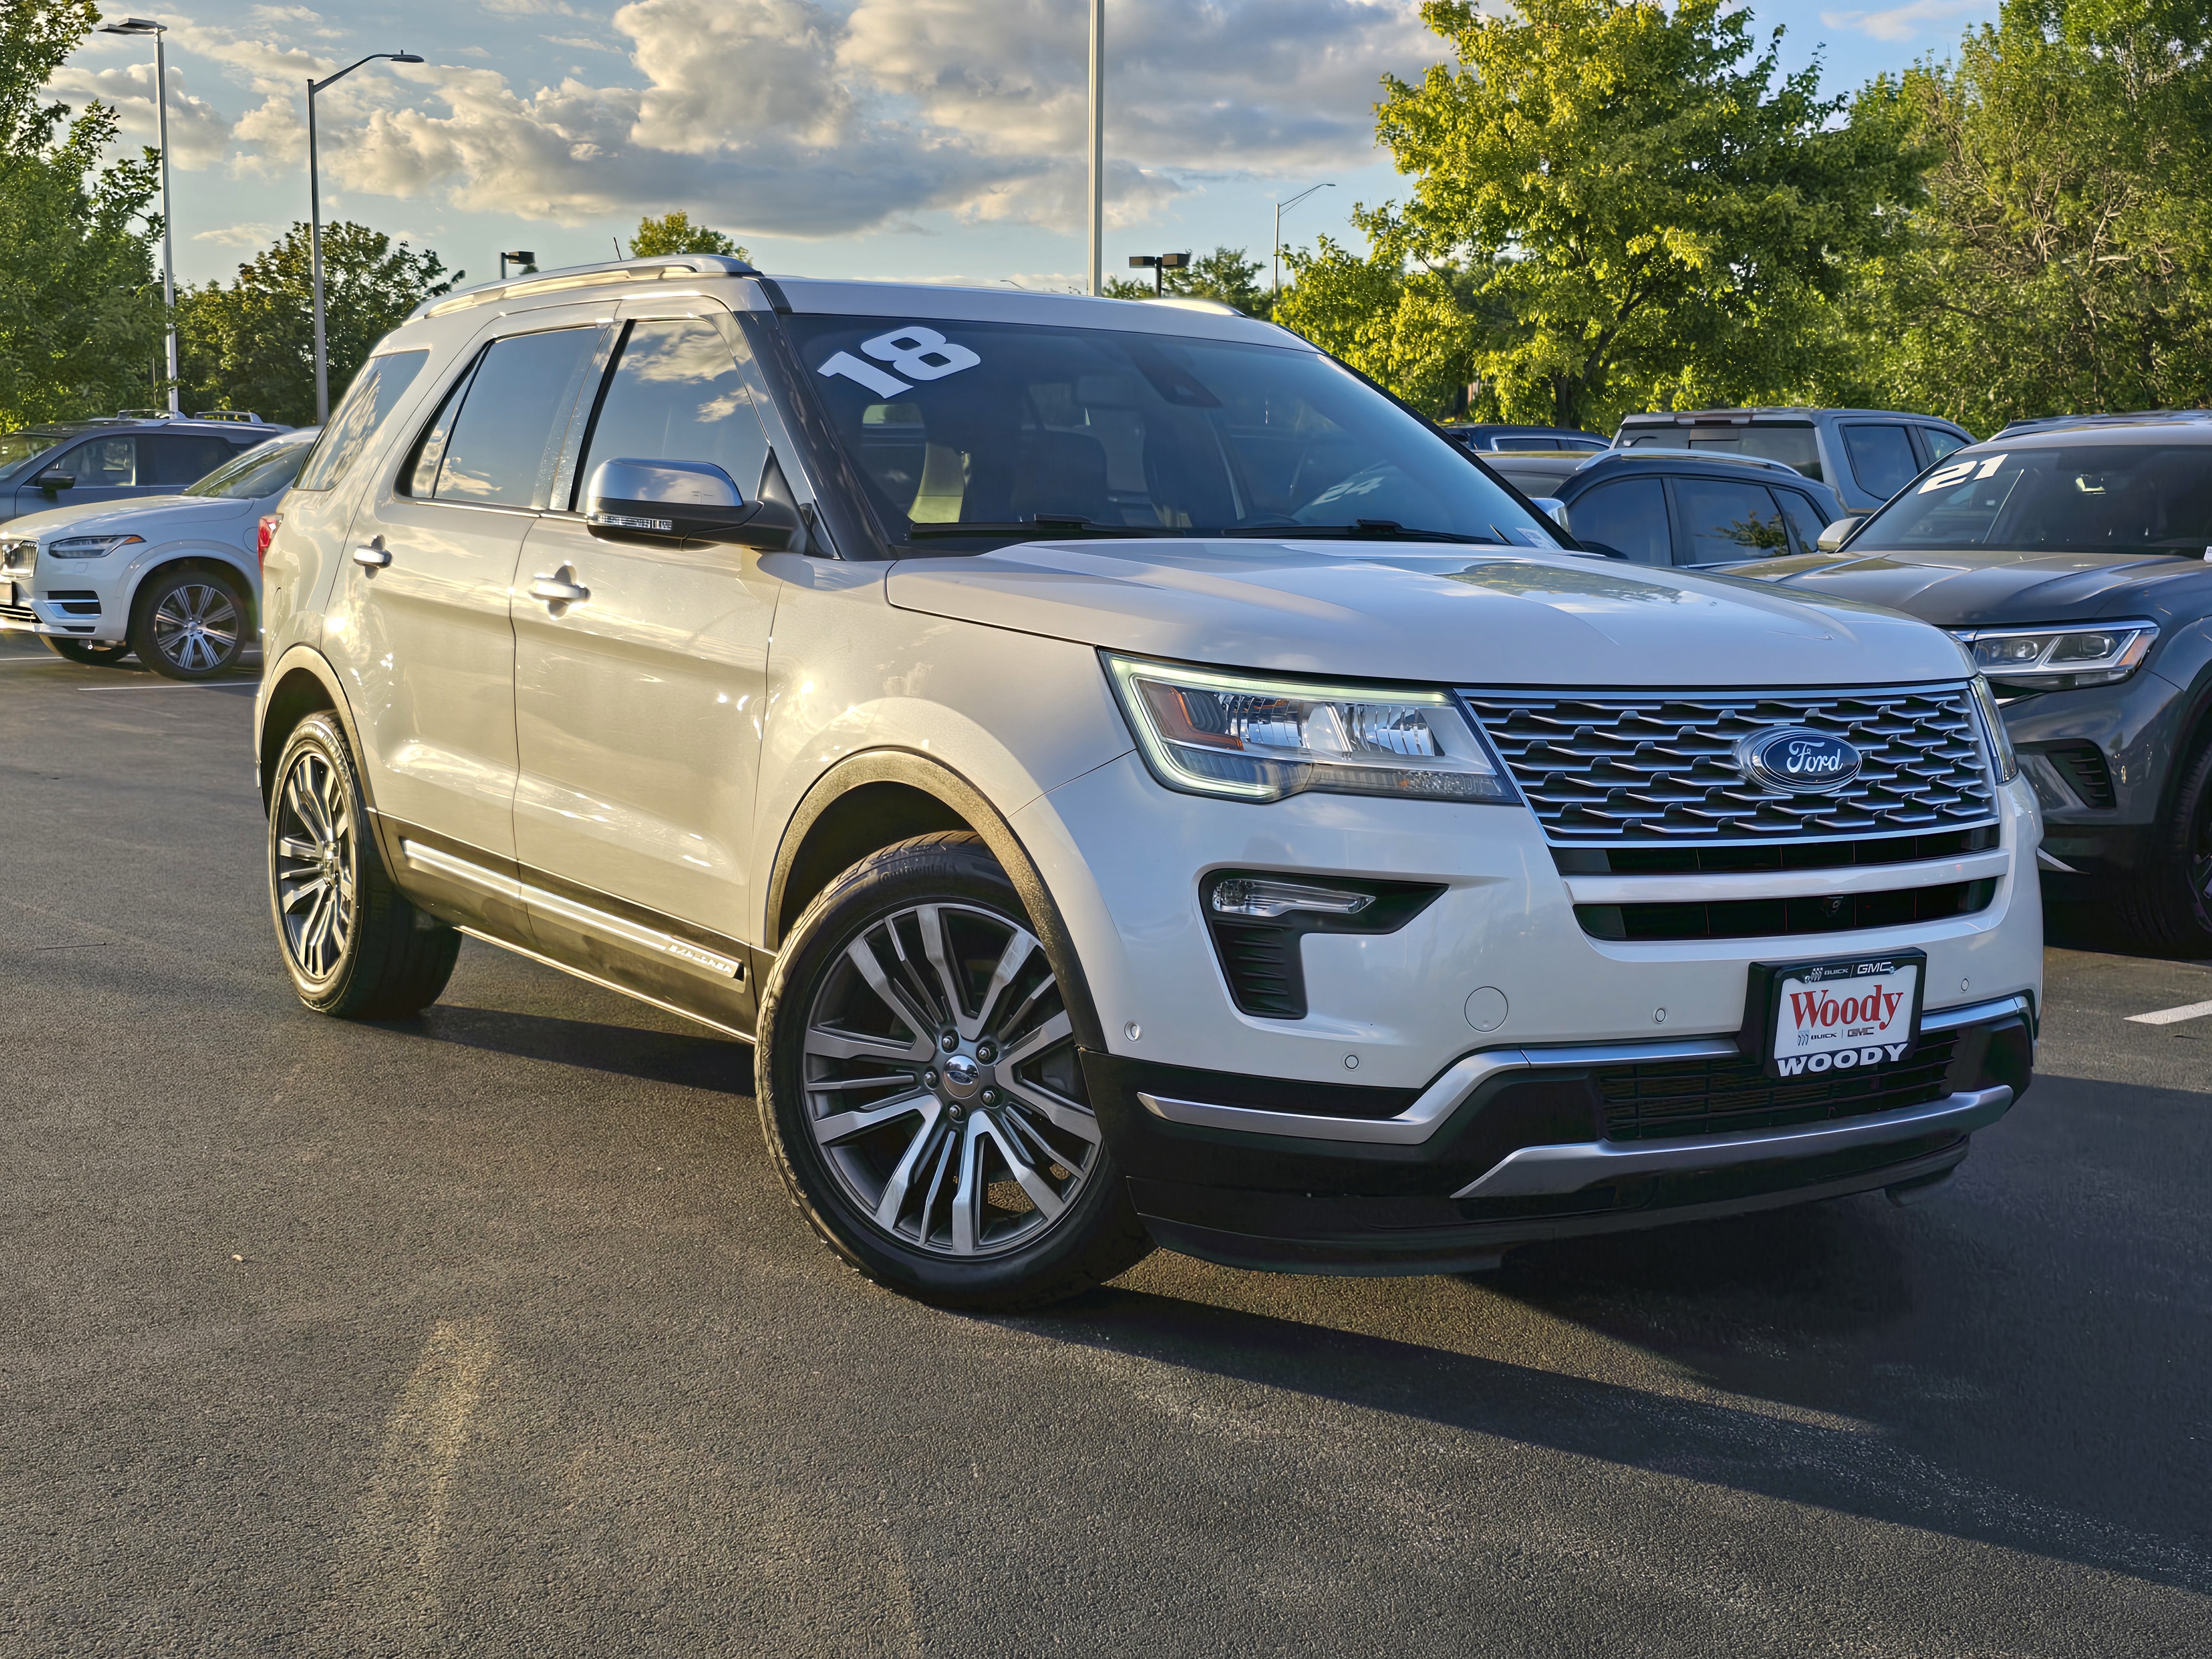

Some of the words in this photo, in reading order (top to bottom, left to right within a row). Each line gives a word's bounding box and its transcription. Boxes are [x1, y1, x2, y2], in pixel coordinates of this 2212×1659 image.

[817, 326, 980, 399] 18
[1917, 454, 2008, 494] 21
[1787, 741, 1843, 773] Ford
[1857, 962, 1891, 974] GMC
[1790, 984, 1903, 1030] Woody
[1848, 1027, 1874, 1037] GMC
[1777, 1044, 1908, 1077] WOODY
